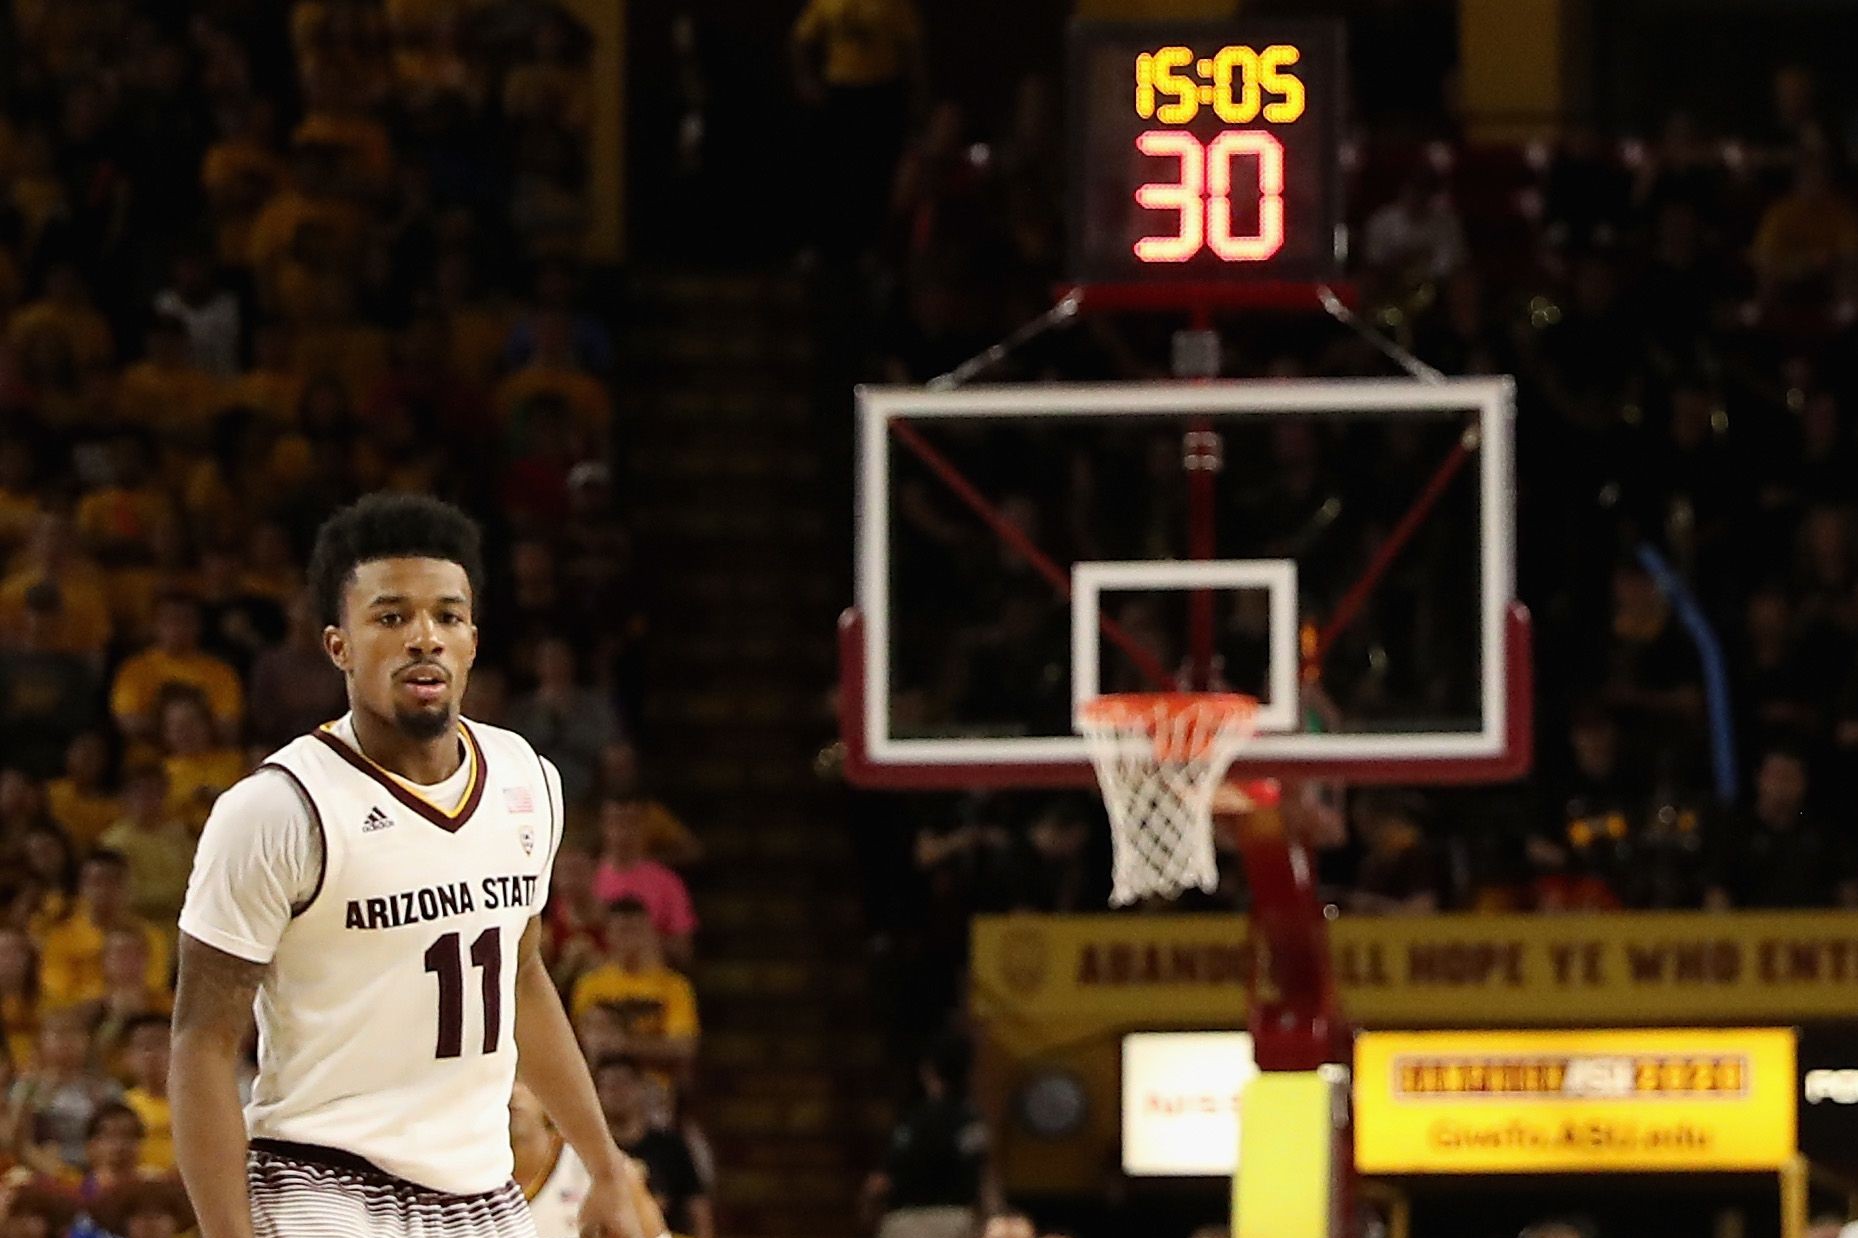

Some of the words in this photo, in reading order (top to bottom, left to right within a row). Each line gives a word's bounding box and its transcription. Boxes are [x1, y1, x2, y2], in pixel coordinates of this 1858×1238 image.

[1135, 44, 1306, 125] 15:05
[1134, 130, 1285, 262] 30
[346, 881, 475, 930] ARIZONA
[424, 926, 502, 1060] 11
[1624, 940, 1742, 985] WHO
